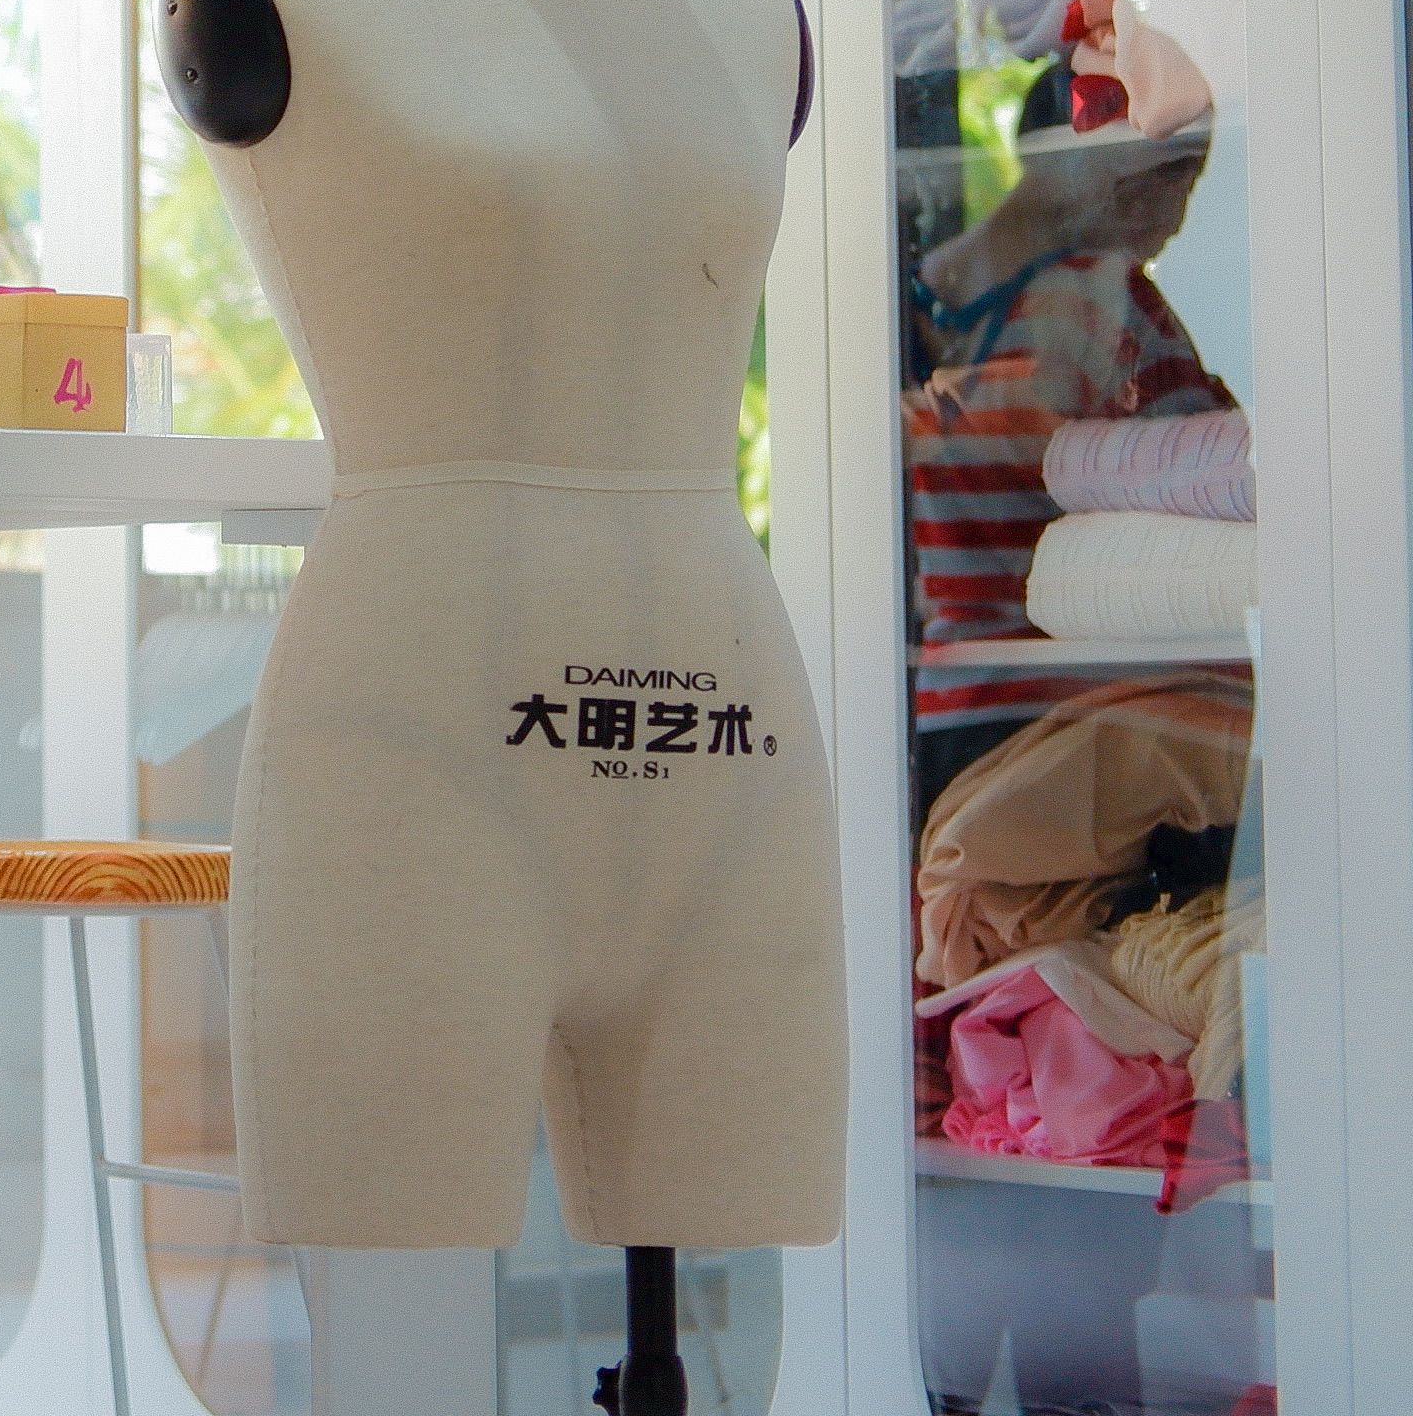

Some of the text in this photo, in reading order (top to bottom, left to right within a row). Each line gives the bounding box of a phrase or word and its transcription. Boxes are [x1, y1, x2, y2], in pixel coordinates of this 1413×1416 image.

[53, 358, 92, 412] 4
[564, 665, 717, 691] DAIMING
[506, 694, 753, 756] 大明艺术
